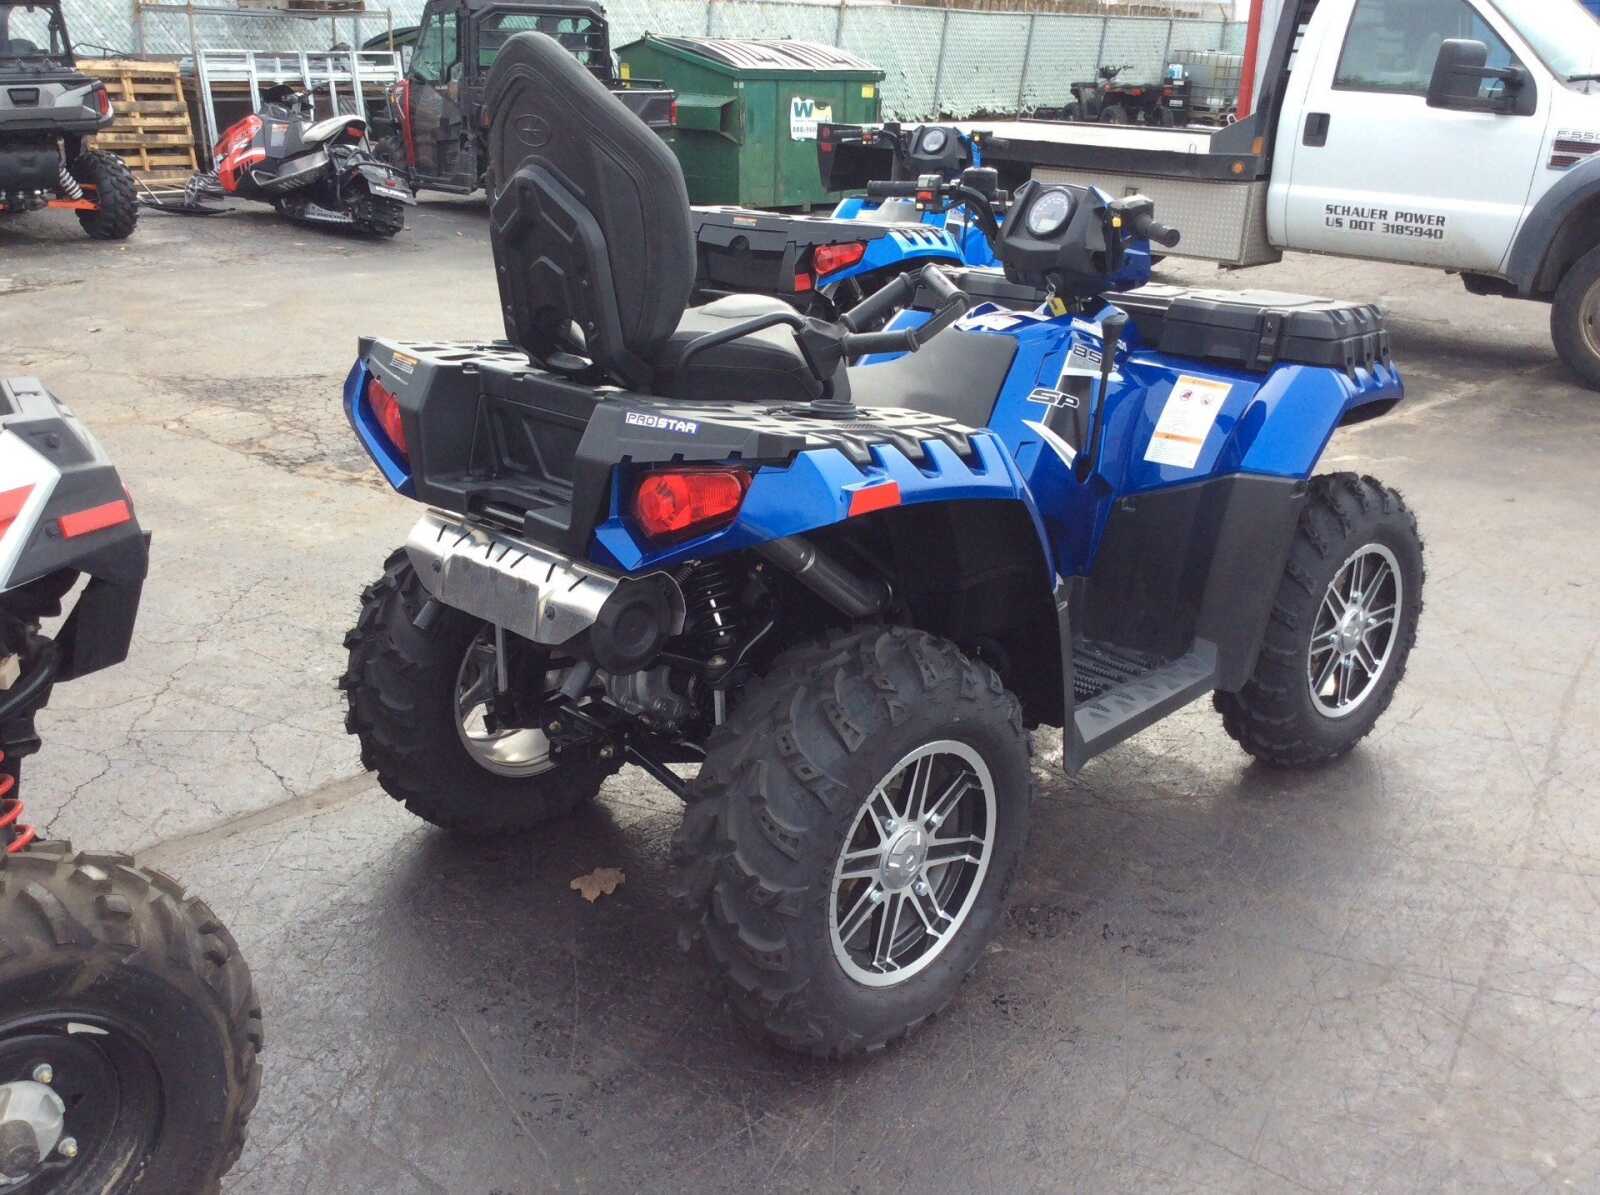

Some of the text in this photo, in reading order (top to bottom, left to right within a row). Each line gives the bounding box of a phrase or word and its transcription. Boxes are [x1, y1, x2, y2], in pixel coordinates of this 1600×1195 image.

[1325, 204, 1446, 227] SCHAUER POWER
[1325, 217, 1444, 240] US DOT 3185940
[1026, 388, 1080, 408] SP
